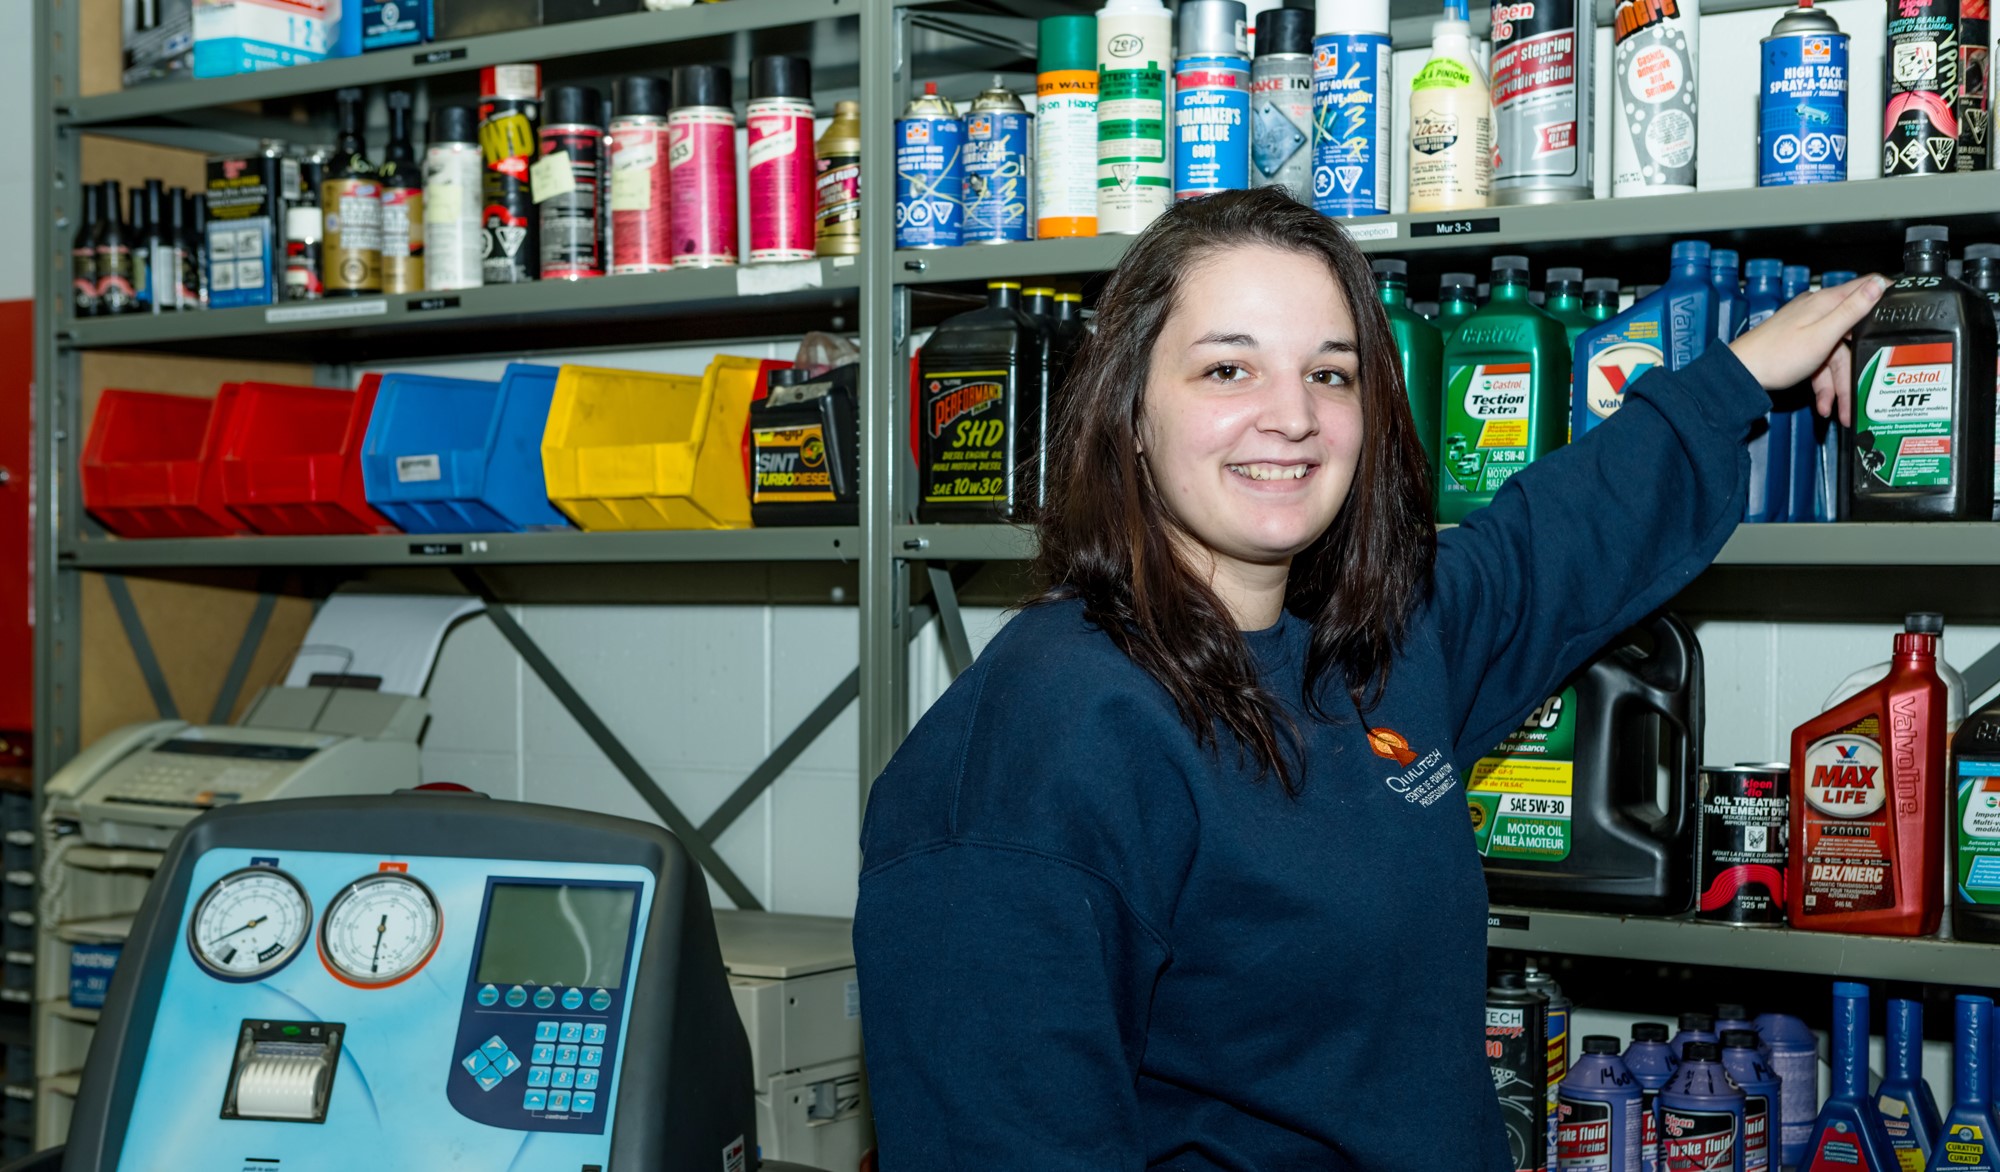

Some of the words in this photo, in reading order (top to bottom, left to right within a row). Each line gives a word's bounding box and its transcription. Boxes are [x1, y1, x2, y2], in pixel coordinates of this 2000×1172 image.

[1520, 37, 1572, 62] steering
[1436, 69, 1470, 84] PINIONS
[1784, 66, 1814, 80] HIGH
[1817, 66, 1842, 79] TACK
[1182, 125, 1200, 143] INK
[1200, 124, 1230, 141] BLUE
[1436, 223, 1454, 234] Mur
[1454, 222, 1472, 233] 3-3
[1492, 379, 1523, 390] Castrol
[1896, 370, 1941, 385] Castrol
[1879, 387, 1907, 395] Domestic
[1472, 393, 1525, 405] Tection
[1891, 393, 1932, 408] ATF
[935, 384, 1002, 438] PERFORMANCE
[1478, 405, 1518, 415] Extra
[952, 419, 1005, 448] SHD
[758, 452, 800, 472] SINT
[942, 451, 964, 460] DIESEL
[964, 450, 990, 460] ENGINE
[1492, 450, 1504, 461] SAE
[1503, 450, 1525, 461] 15W-40
[758, 472, 831, 487] TURBODIESEL
[932, 483, 953, 495] SAE
[1518, 730, 1549, 741] Power.
[1506, 743, 1549, 753] puissance.
[1891, 695, 1922, 817] Valvoline
[1742, 778, 1773, 789] kleen
[1811, 764, 1880, 789] MAX
[1713, 796, 1732, 806] OIL
[1822, 789, 1868, 805] LIFE
[1510, 797, 1527, 812] SAE
[1528, 798, 1565, 814] 5W-30
[1703, 804, 1769, 816] TRAITEMENT
[1507, 823, 1546, 836] MOTOR
[1546, 825, 1565, 837] OIL
[1492, 834, 1518, 847] HUILE
[1517, 834, 1526, 847] À
[1526, 836, 1564, 850] MOTEUR
[1811, 864, 1884, 884] DEX/MERC
[1741, 901, 1756, 909] 325
[1757, 901, 1767, 910] ml
[1664, 1113, 1695, 1128] kleen
[1579, 1124, 1607, 1142] fluid
[1670, 1141, 1702, 1157] brake
[1704, 1134, 1732, 1154] fluid
[1947, 1142, 1982, 1153] CURATIVE
[1949, 1154, 1979, 1163] CURATIF
